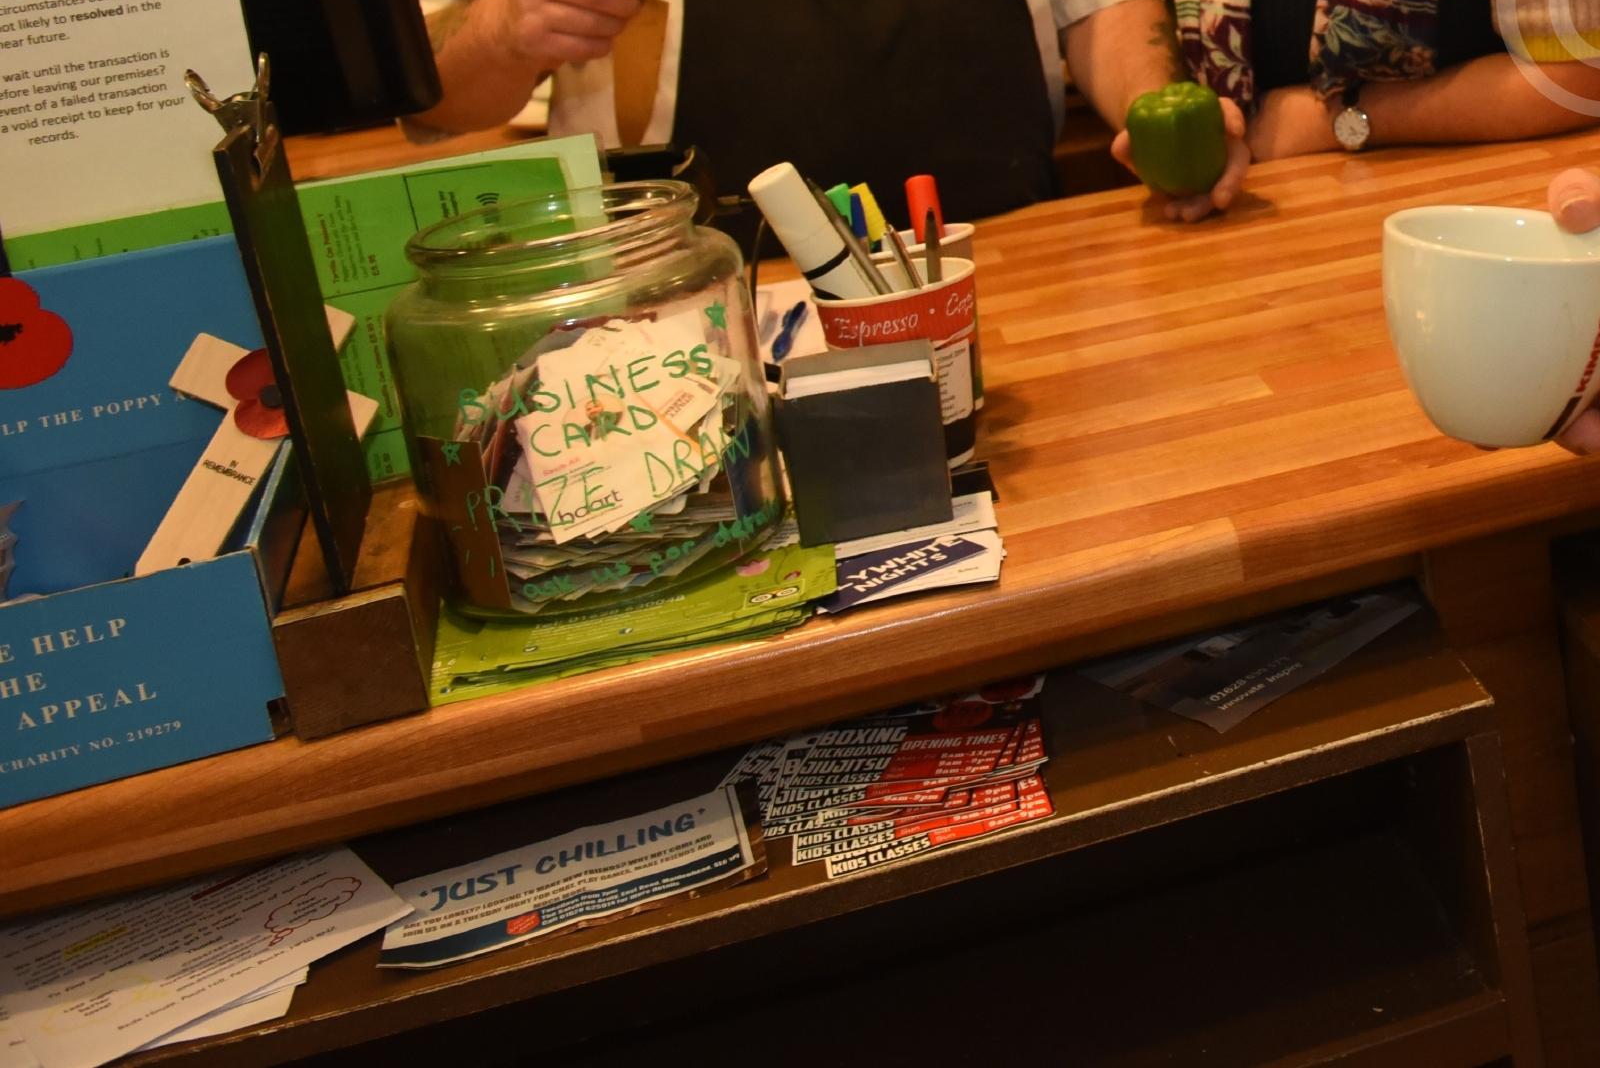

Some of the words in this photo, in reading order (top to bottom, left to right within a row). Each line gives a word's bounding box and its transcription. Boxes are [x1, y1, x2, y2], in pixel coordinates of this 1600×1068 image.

[18, 16, 51, 32] likely
[53, 14, 67, 25] to
[70, 6, 125, 23] resolved
[126, 3, 140, 14] in
[140, 0, 162, 13] the
[27, 30, 71, 47] future.
[3, 72, 32, 84] wait
[33, 64, 62, 79] until
[64, 60, 86, 73] the
[88, 50, 158, 69] transaction
[160, 48, 171, 59] is
[33, 79, 78, 97] leaving
[80, 75, 101, 88] our
[105, 64, 167, 86] premises?
[34, 98, 48, 112] of
[50, 100, 59, 110] a
[60, 91, 96, 108] failed
[98, 82, 168, 102] transaction
[12, 118, 39, 132] void
[42, 112, 86, 131] receipt
[88, 108, 102, 120] to
[104, 103, 135, 119] keep
[137, 99, 155, 112] for
[158, 95, 186, 111] your
[28, 128, 80, 147] records.
[833, 313, 919, 348] Espresso
[458, 343, 715, 426] BUSINESS
[38, 408, 85, 430] THE
[92, 392, 163, 419] POPPY
[530, 403, 660, 459] CARD
[643, 426, 753, 499] DRAW
[853, 552, 948, 593] NIGHTS
[32, 617, 128, 656] HELP
[17, 681, 158, 731] APPEAL
[126, 719, 183, 743] 219279
[811, 743, 899, 759] KICKBOXING
[901, 736, 962, 751] OPENING
[964, 732, 1008, 746] TIMES
[819, 726, 909, 746] BOXING
[801, 756, 892, 774] JIUJITSU
[827, 771, 882, 784] CLASSES
[771, 801, 805, 818] KIDS
[807, 790, 867, 807] CLASSES
[797, 832, 833, 847] KIDS
[834, 820, 895, 839] CLASSES
[797, 845, 833, 861] KIDS
[834, 829, 896, 853] CLASSES
[831, 855, 868, 876] KIDS
[869, 836, 932, 864] CLASSES
